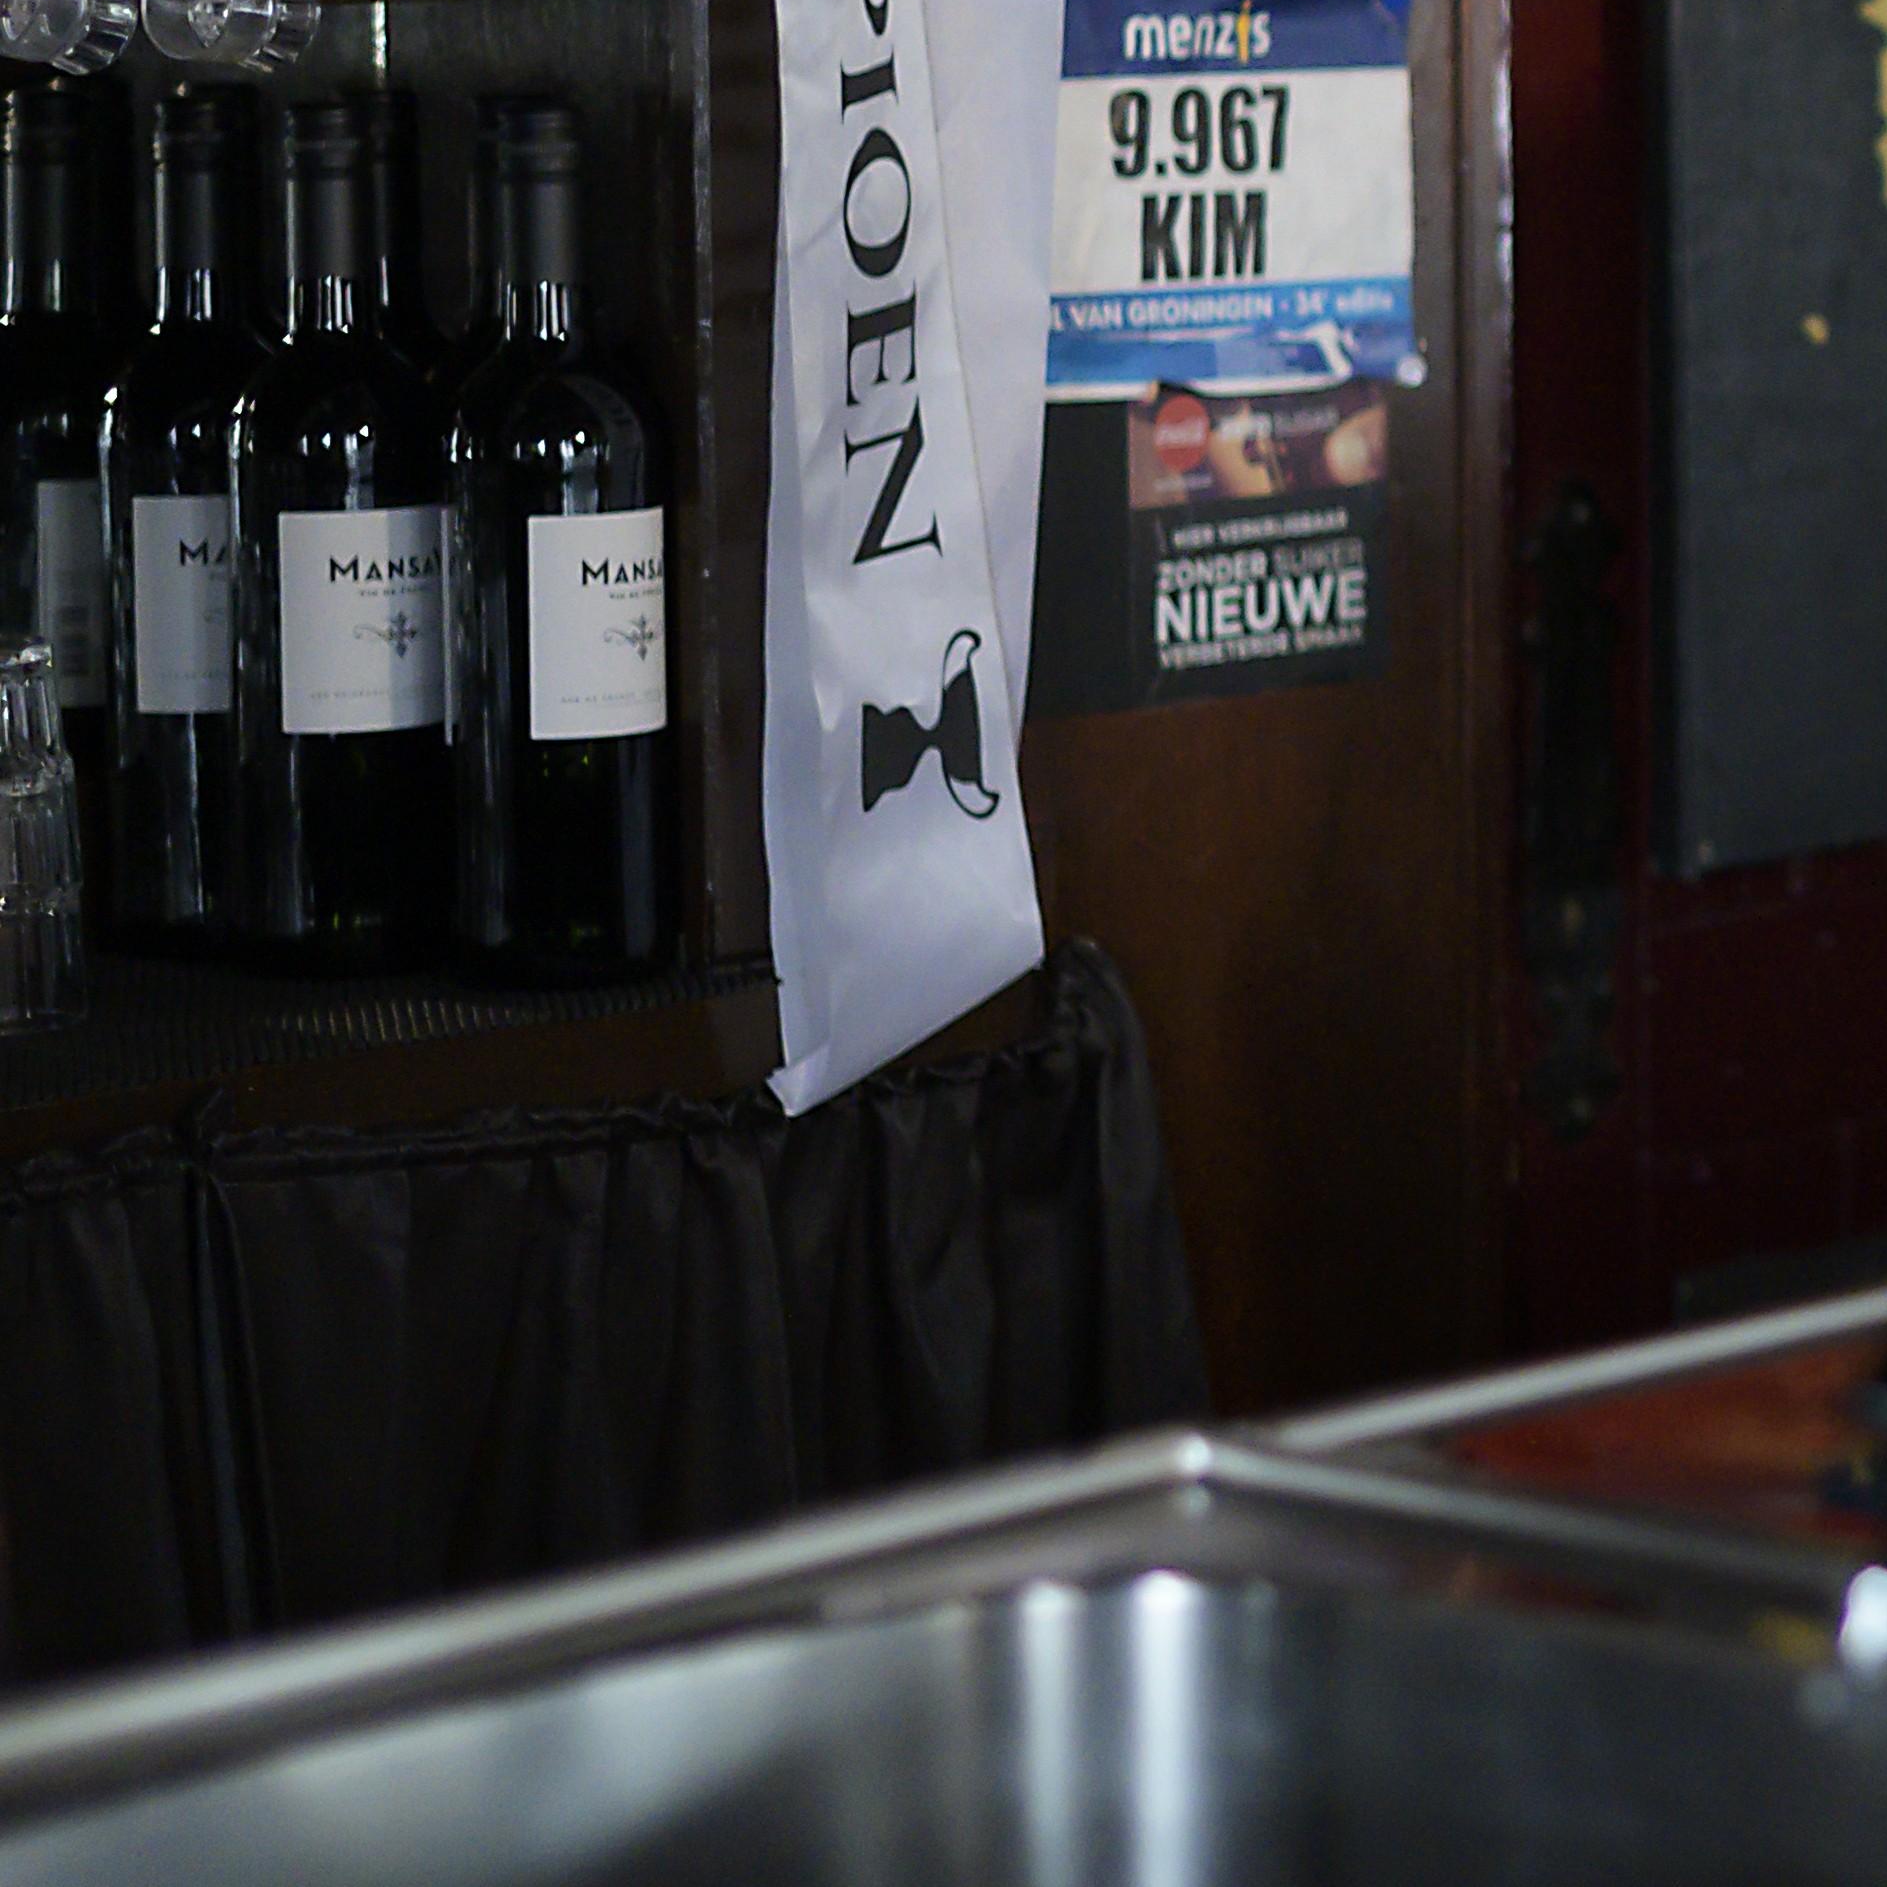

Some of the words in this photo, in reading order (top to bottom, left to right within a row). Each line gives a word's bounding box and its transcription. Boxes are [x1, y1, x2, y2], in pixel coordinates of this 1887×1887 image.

[1109, 83, 1291, 180] 9.967
[1141, 189, 1267, 281] KIM
[1069, 300, 1122, 329] VAN
[1127, 293, 1273, 327] GRONINGEN
[1156, 567, 1367, 645] NIEUWE
[1157, 548, 1268, 592] ZONDER
